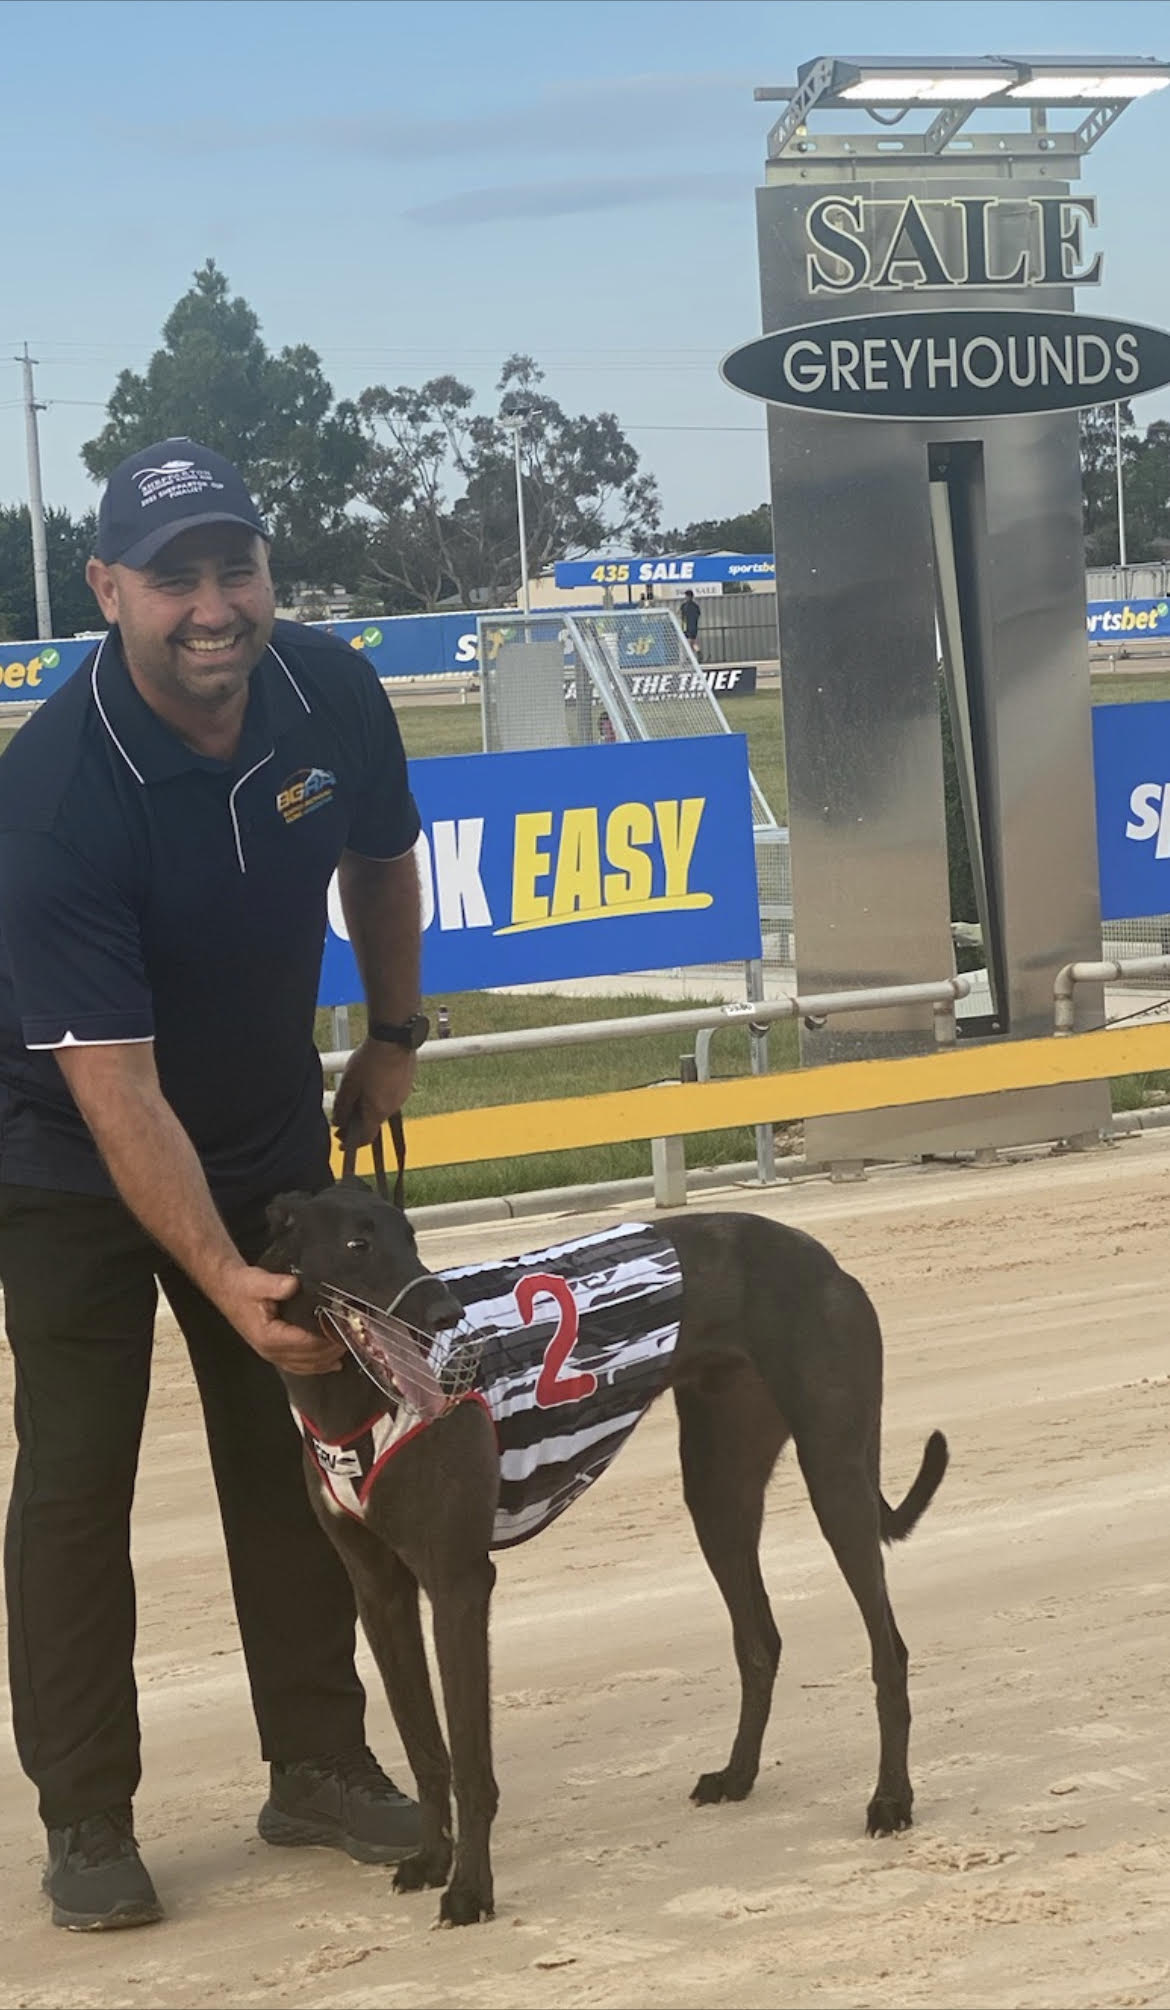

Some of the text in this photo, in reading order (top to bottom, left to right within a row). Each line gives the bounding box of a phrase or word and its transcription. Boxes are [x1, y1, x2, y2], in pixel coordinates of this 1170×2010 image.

[805, 195, 1104, 294] SALE
[783, 333, 1140, 392] GREYHOUNDS
[591, 565, 630, 582] 435
[638, 562, 695, 581] SALE
[0, 656, 43, 689] et
[632, 674, 674, 694] THE
[679, 669, 742, 692] THIEF
[511, 797, 706, 924] EASY
[514, 1273, 597, 1408] 2
